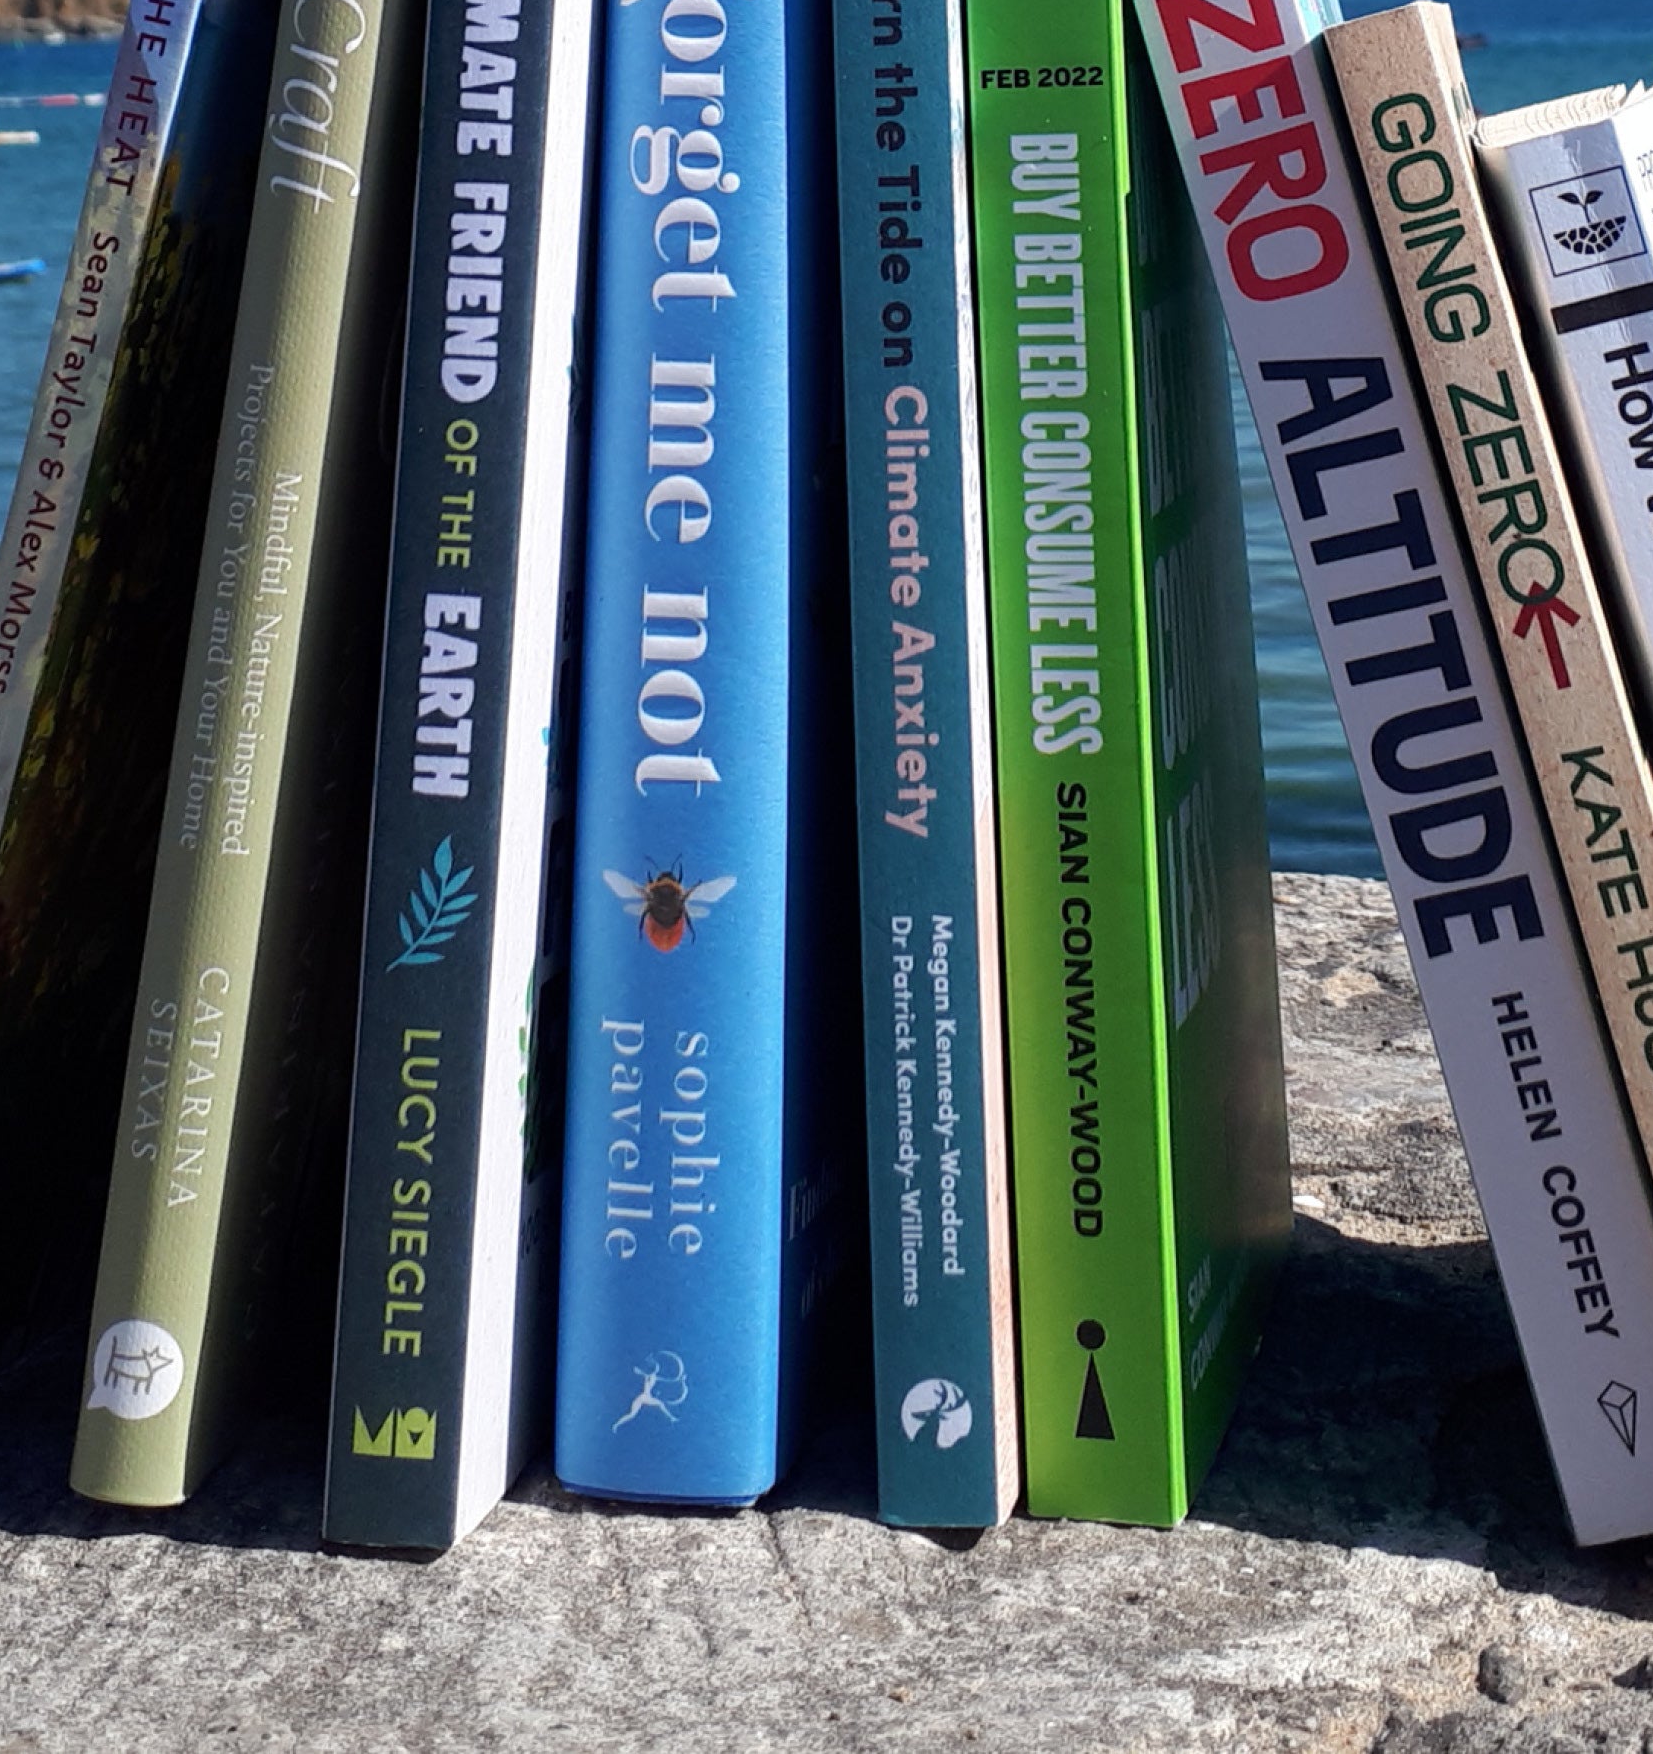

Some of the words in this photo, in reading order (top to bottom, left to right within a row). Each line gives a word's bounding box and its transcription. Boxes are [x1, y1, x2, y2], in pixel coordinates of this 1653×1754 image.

[106, 75, 157, 196] HEAT
[874, 62, 918, 152] the
[980, 69, 1030, 88] FEB
[1038, 66, 1104, 88] 2022
[877, 165, 922, 285] Tide
[1010, 133, 1081, 221] BUY
[76, 231, 119, 318] Sean
[441, 180, 509, 404] FRIEND
[882, 301, 913, 367] on
[1014, 233, 1088, 400] BETTER
[46, 334, 97, 448] Taylor
[1372, 92, 1491, 343] GOING
[1447, 370, 1566, 606] ZERO
[39, 458, 64, 480] &
[235, 363, 274, 482] Projects
[444, 417, 479, 477] OF
[644, 352, 716, 544] me
[15, 490, 57, 572] Alex
[228, 489, 256, 532] for
[252, 470, 302, 602] Mindful,
[437, 489, 475, 569] THE
[884, 386, 929, 607] Climate
[1021, 411, 1097, 632] CONSUME
[216, 541, 248, 601] You
[207, 606, 236, 664] and
[412, 590, 482, 799] EARTH
[635, 583, 722, 798] not
[1258, 356, 1545, 960] ALTITUDE
[195, 667, 230, 745] Your
[221, 610, 280, 856] Nature-inspired
[885, 621, 939, 839] Anxiety
[1030, 643, 1103, 756] LESS
[181, 751, 216, 849] Home
[1057, 781, 1090, 884] SIAN
[1561, 746, 1649, 918] KATE
[891, 916, 912, 948] Dr
[928, 914, 954, 1016] Megan
[891, 954, 916, 1052] Patrick
[131, 998, 178, 1161] SEIXAS
[167, 966, 230, 1208] CATARINA
[396, 1028, 443, 1165] LUCY
[1061, 897, 1104, 1238] CONWAY-WOOD
[601, 1015, 653, 1259] pavelle
[658, 1030, 721, 1256] sophie
[894, 1057, 921, 1308] Kennedy-Williams
[934, 1018, 965, 1276] Kennedy-Woodard
[1491, 991, 1562, 1142] HELEN
[1542, 1165, 1620, 1339] COFFEY
[382, 1177, 432, 1358] SIEGLE
